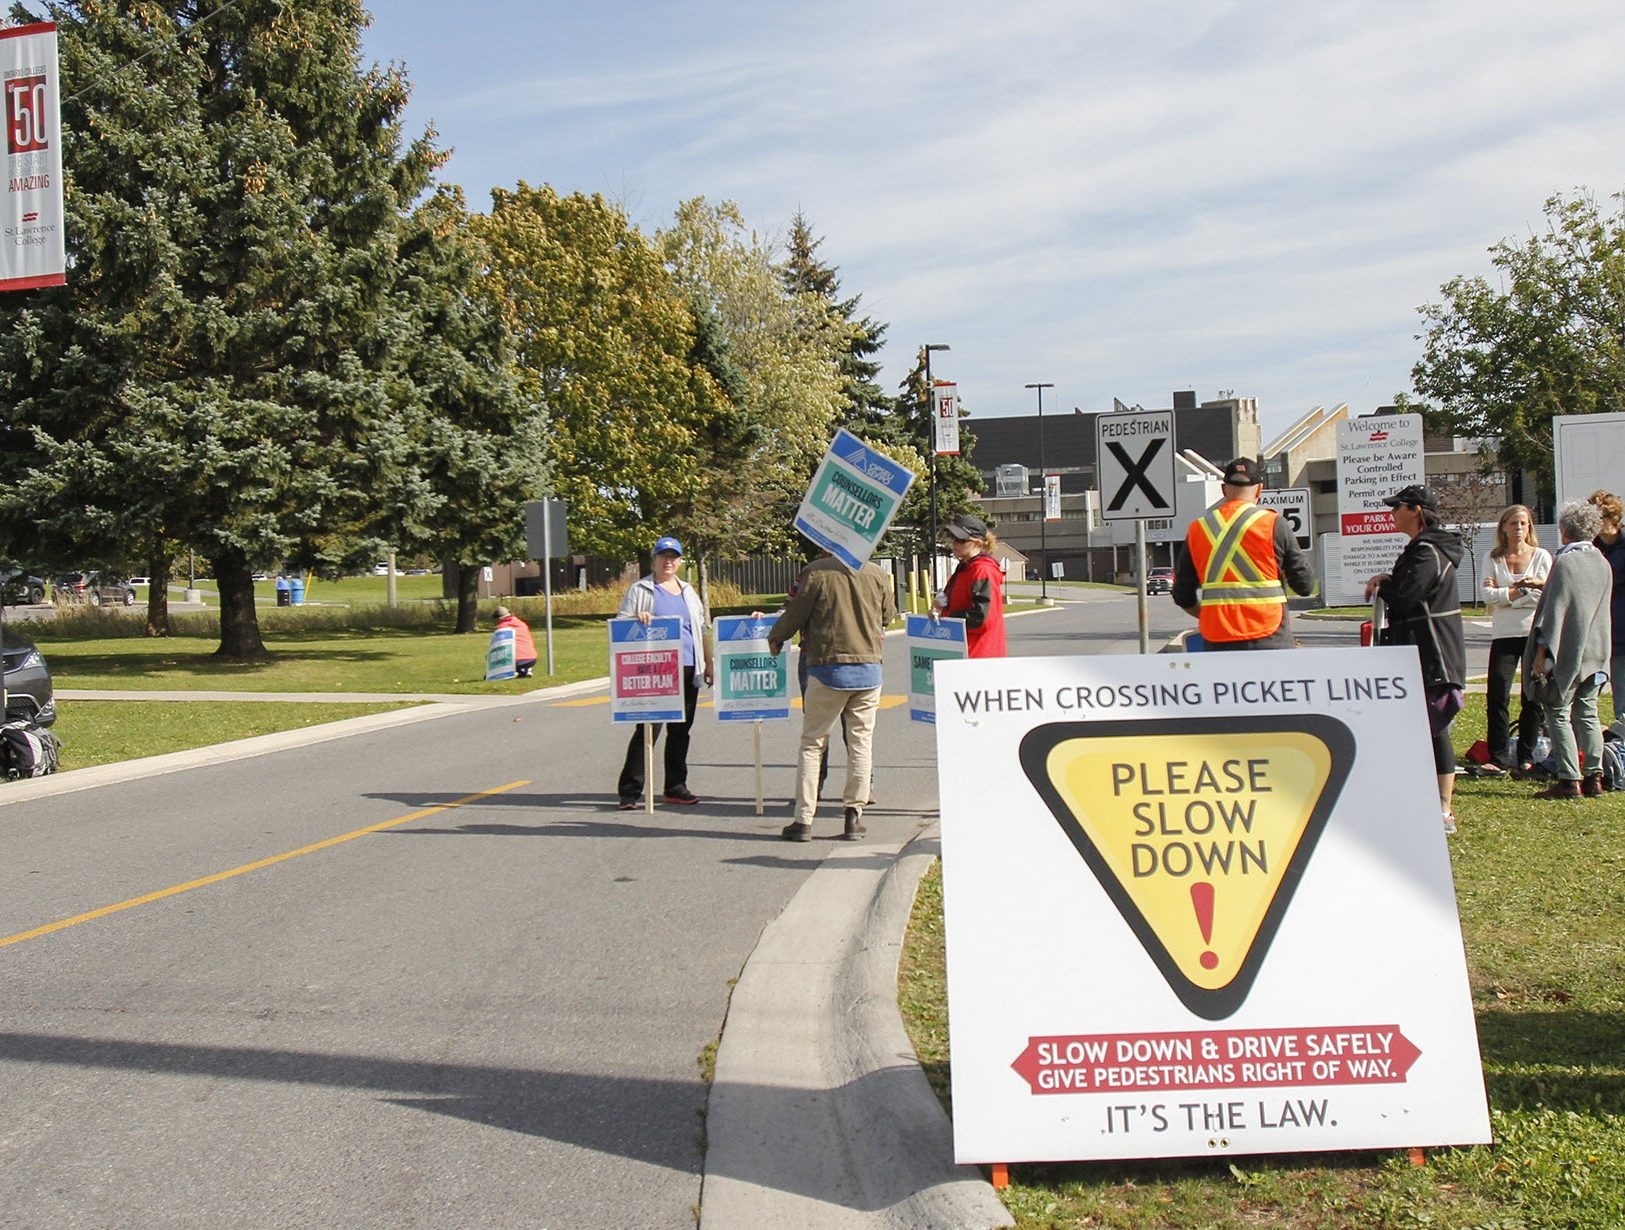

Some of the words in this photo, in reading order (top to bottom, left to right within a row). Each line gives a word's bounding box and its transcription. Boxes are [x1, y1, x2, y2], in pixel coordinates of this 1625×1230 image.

[14, 84, 47, 146] 50
[9, 174, 50, 192] AMAZING
[16, 224, 56, 235] Lawrence
[15, 236, 46, 246] College
[942, 398, 954, 417] 50
[1102, 420, 1169, 437] PEDESTRIAN
[1348, 420, 1397, 432] Welcome
[1399, 419, 1410, 428] to
[1351, 441, 1387, 450] Lawrence
[1390, 439, 1418, 447] College
[1343, 455, 1371, 464] Please
[1374, 453, 1385, 462] be
[1387, 452, 1417, 461] Aware
[1357, 462, 1403, 473] Controlled
[1345, 476, 1377, 486] Parking
[1379, 474, 1388, 482] in
[1391, 473, 1416, 482] Effect
[832, 471, 883, 509] COUNSELLORS
[1349, 488, 1375, 498] Permit
[1377, 489, 1386, 497] or
[821, 483, 876, 529] MATTER
[1364, 514, 1386, 523] PARK
[1388, 514, 1395, 522] A
[1346, 524, 1372, 533] YOUR
[647, 652, 672, 663] FACULTY
[730, 657, 778, 670] COUNSELLORS
[914, 655, 931, 670] SAME
[622, 675, 651, 690] BETTER
[653, 674, 673, 689] PLAN
[729, 670, 778, 691] MATTER
[955, 688, 1044, 715] WHEN
[1056, 683, 1202, 710] CROSSING
[1214, 679, 1316, 705] PICKET
[1328, 676, 1408, 702] LINES
[1112, 758, 1272, 796] PLEASE
[1134, 800, 1257, 836] SLOW
[1132, 840, 1268, 878] DOWN
[1037, 1039, 1109, 1066] SLOW
[1117, 1036, 1193, 1061] DOWN
[1201, 1037, 1219, 1060] &
[1227, 1034, 1299, 1059] DRIVE
[1306, 1032, 1394, 1056] SAFELY
[1038, 1067, 1088, 1089] GIVE
[1094, 1063, 1236, 1088] PEDESTRIANS
[1242, 1061, 1305, 1083] RIGHT
[1311, 1060, 1340, 1080] OF
[1345, 1058, 1398, 1079] WAY.
[1106, 1104, 1169, 1133] IT'S
[1179, 1102, 1246, 1130] THE
[1260, 1098, 1338, 1128] LAW.
